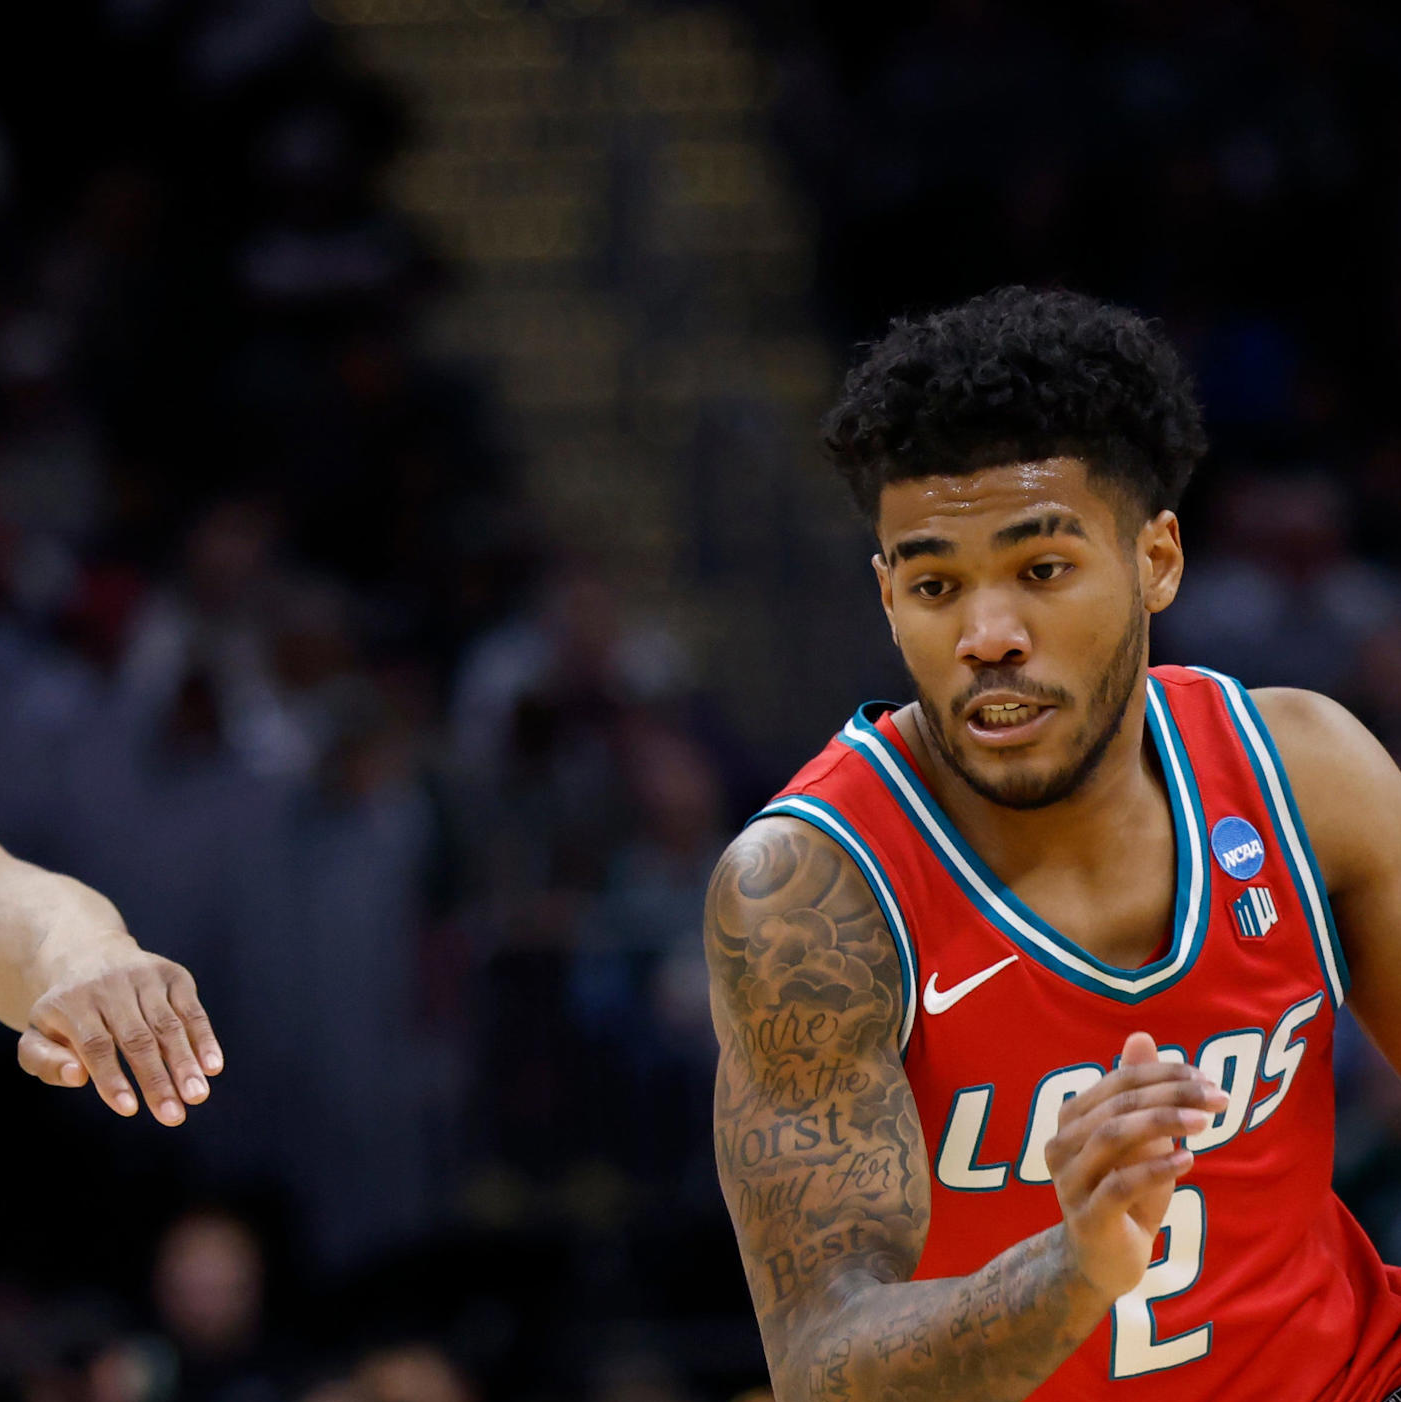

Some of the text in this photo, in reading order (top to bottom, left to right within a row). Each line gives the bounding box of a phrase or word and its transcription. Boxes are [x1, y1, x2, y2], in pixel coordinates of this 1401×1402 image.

[1222, 839, 1263, 869] NCAA
[806, 1058, 871, 1098] the
[934, 989, 1325, 1193] LOOS
[827, 1146, 902, 1199] for
[765, 1225, 866, 1300] Best
[1108, 1184, 1214, 1381] 2
